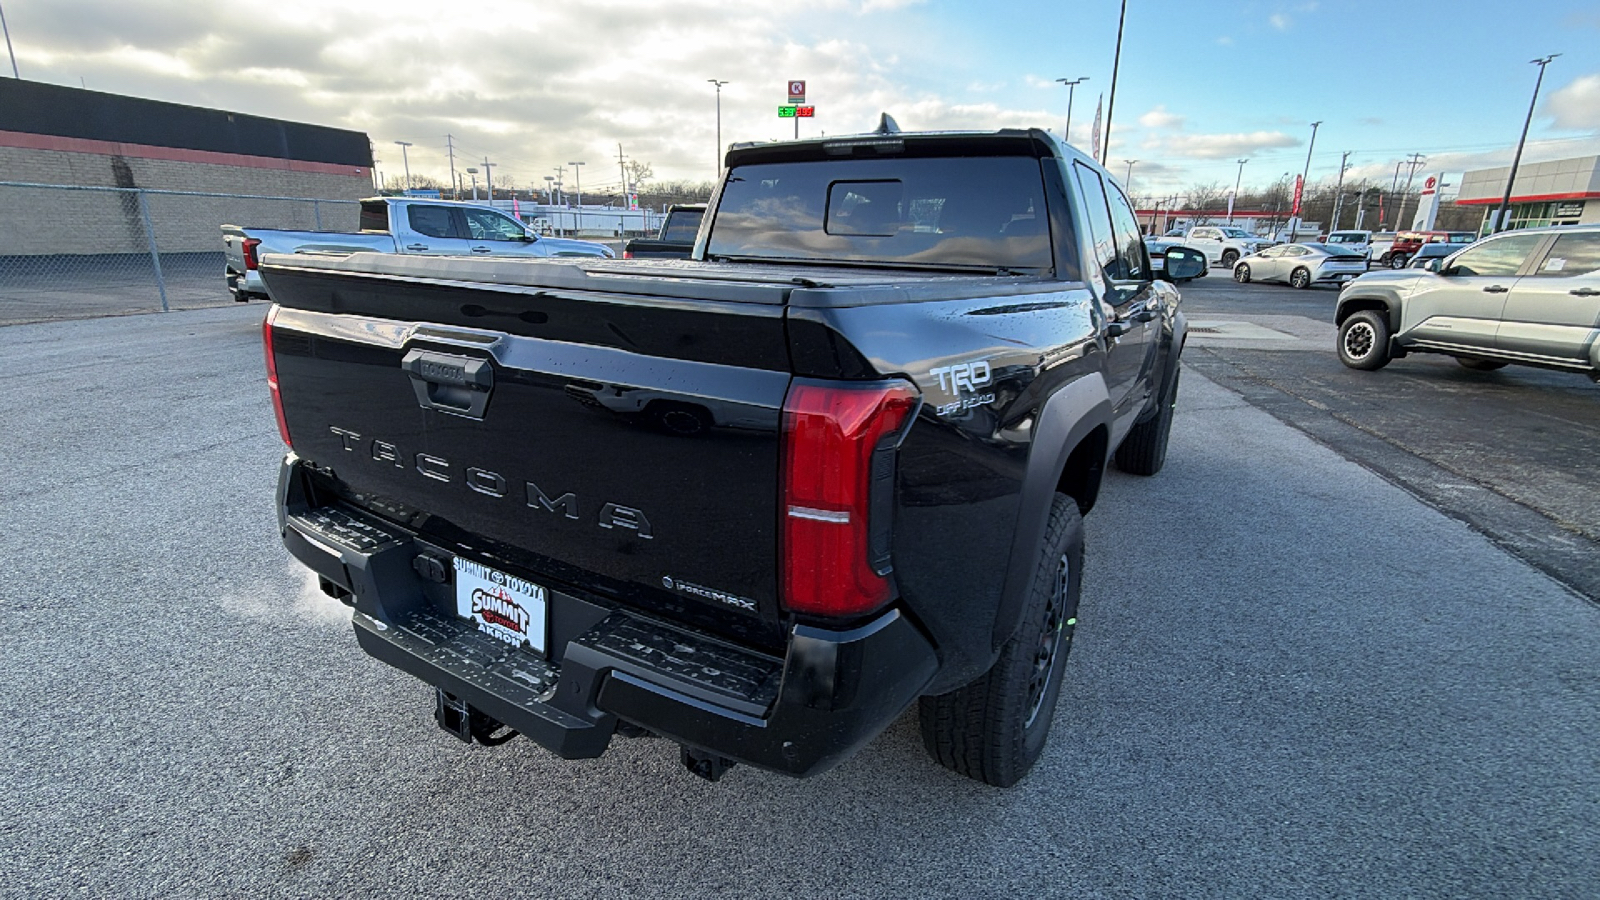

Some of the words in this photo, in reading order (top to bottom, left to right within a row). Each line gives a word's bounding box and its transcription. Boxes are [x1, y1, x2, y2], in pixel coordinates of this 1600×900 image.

[423, 362, 464, 381] TOYOTA
[930, 361, 991, 395] TRD
[329, 425, 654, 539] TACOMA
[453, 556, 491, 580] SUMMIT
[505, 575, 545, 602] TOYOTA
[472, 590, 530, 634] SUMMIT
[495, 615, 520, 632] TOYOTA
[478, 624, 521, 648] AKRON
